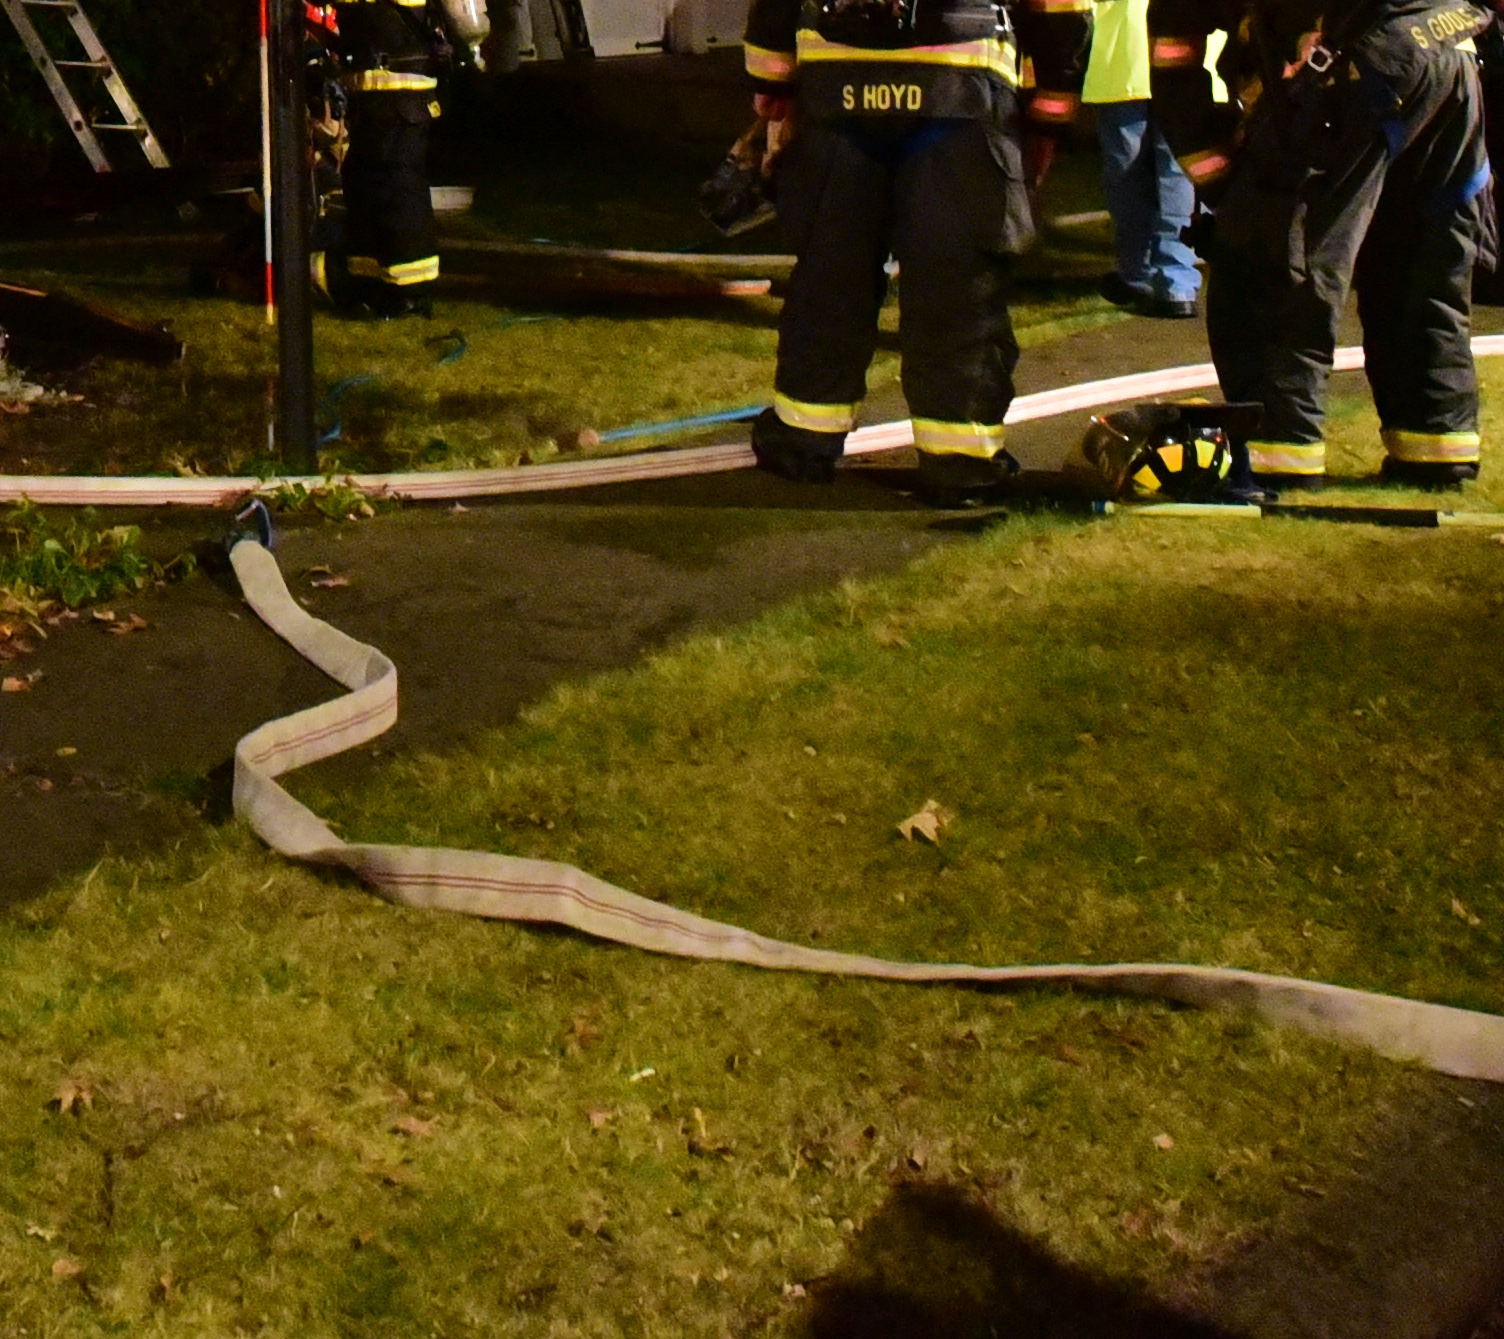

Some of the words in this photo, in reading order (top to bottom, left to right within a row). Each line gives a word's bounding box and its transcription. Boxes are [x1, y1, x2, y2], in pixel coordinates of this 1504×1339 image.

[1411, 26, 1429, 50] S
[842, 84, 855, 110] S
[863, 83, 922, 111] HOYD
